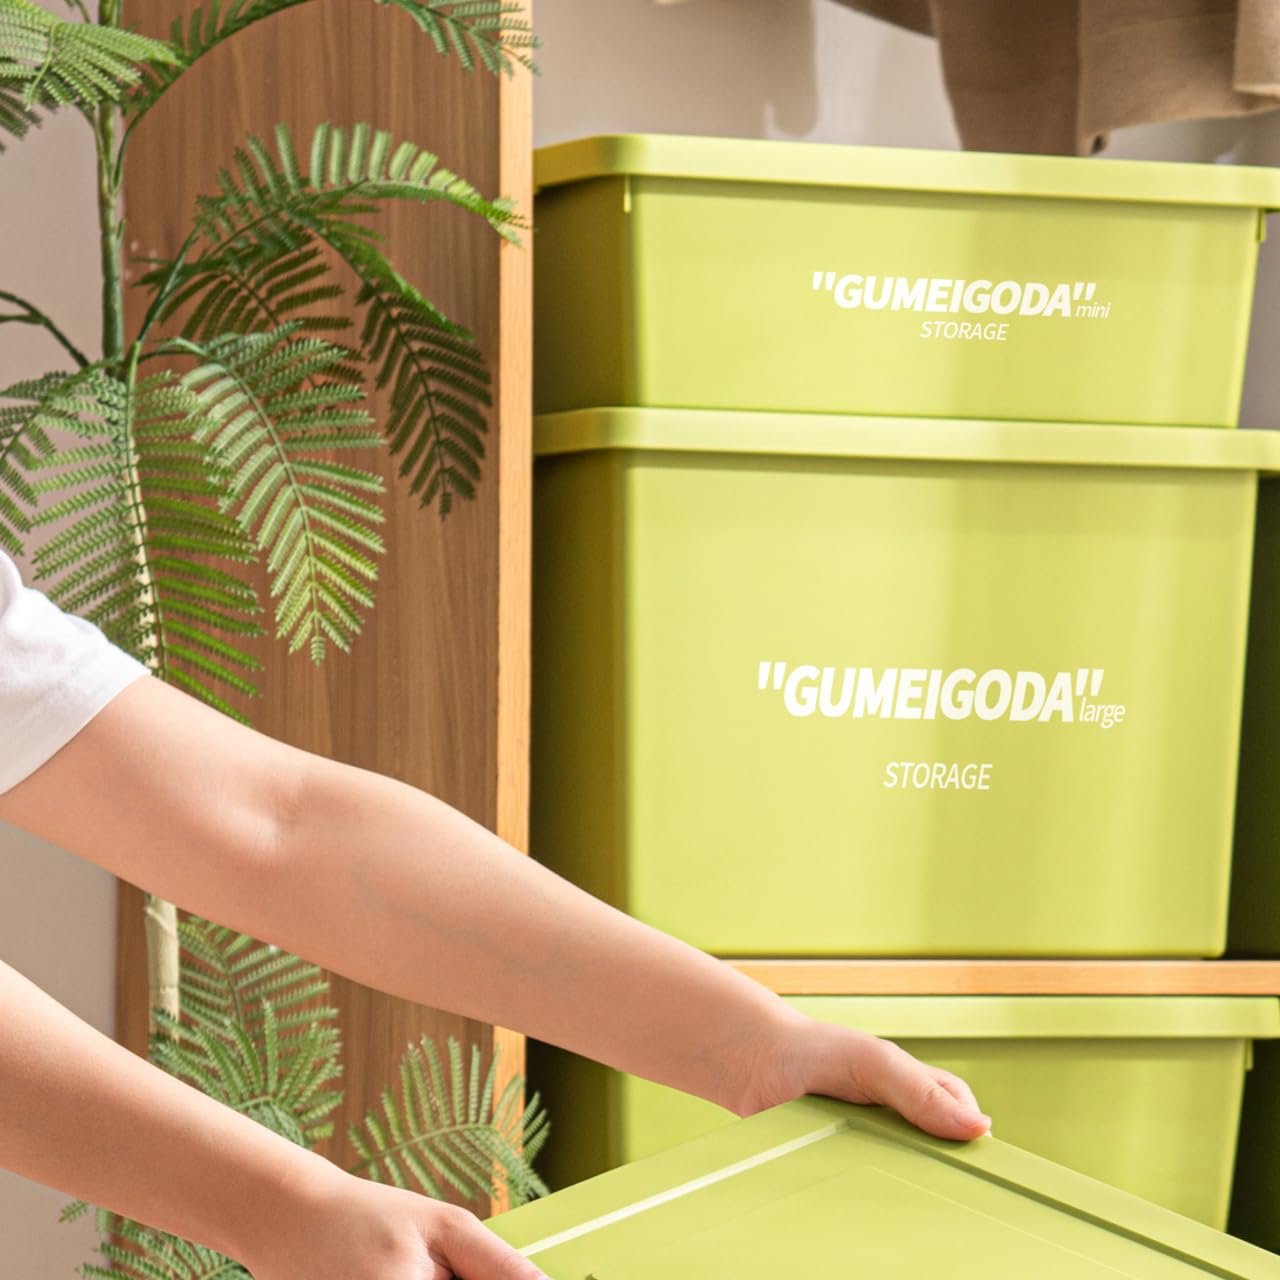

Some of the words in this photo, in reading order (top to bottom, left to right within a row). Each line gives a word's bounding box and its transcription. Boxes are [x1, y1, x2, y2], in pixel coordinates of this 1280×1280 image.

[812, 271, 1097, 320] "GUMEIGODA"
[1075, 300, 1111, 319] mini
[919, 320, 1009, 341] STORAGE
[757, 660, 1105, 723] "GUMEIGODA"
[1078, 696, 1126, 732] large
[882, 761, 993, 791] STORAGE
